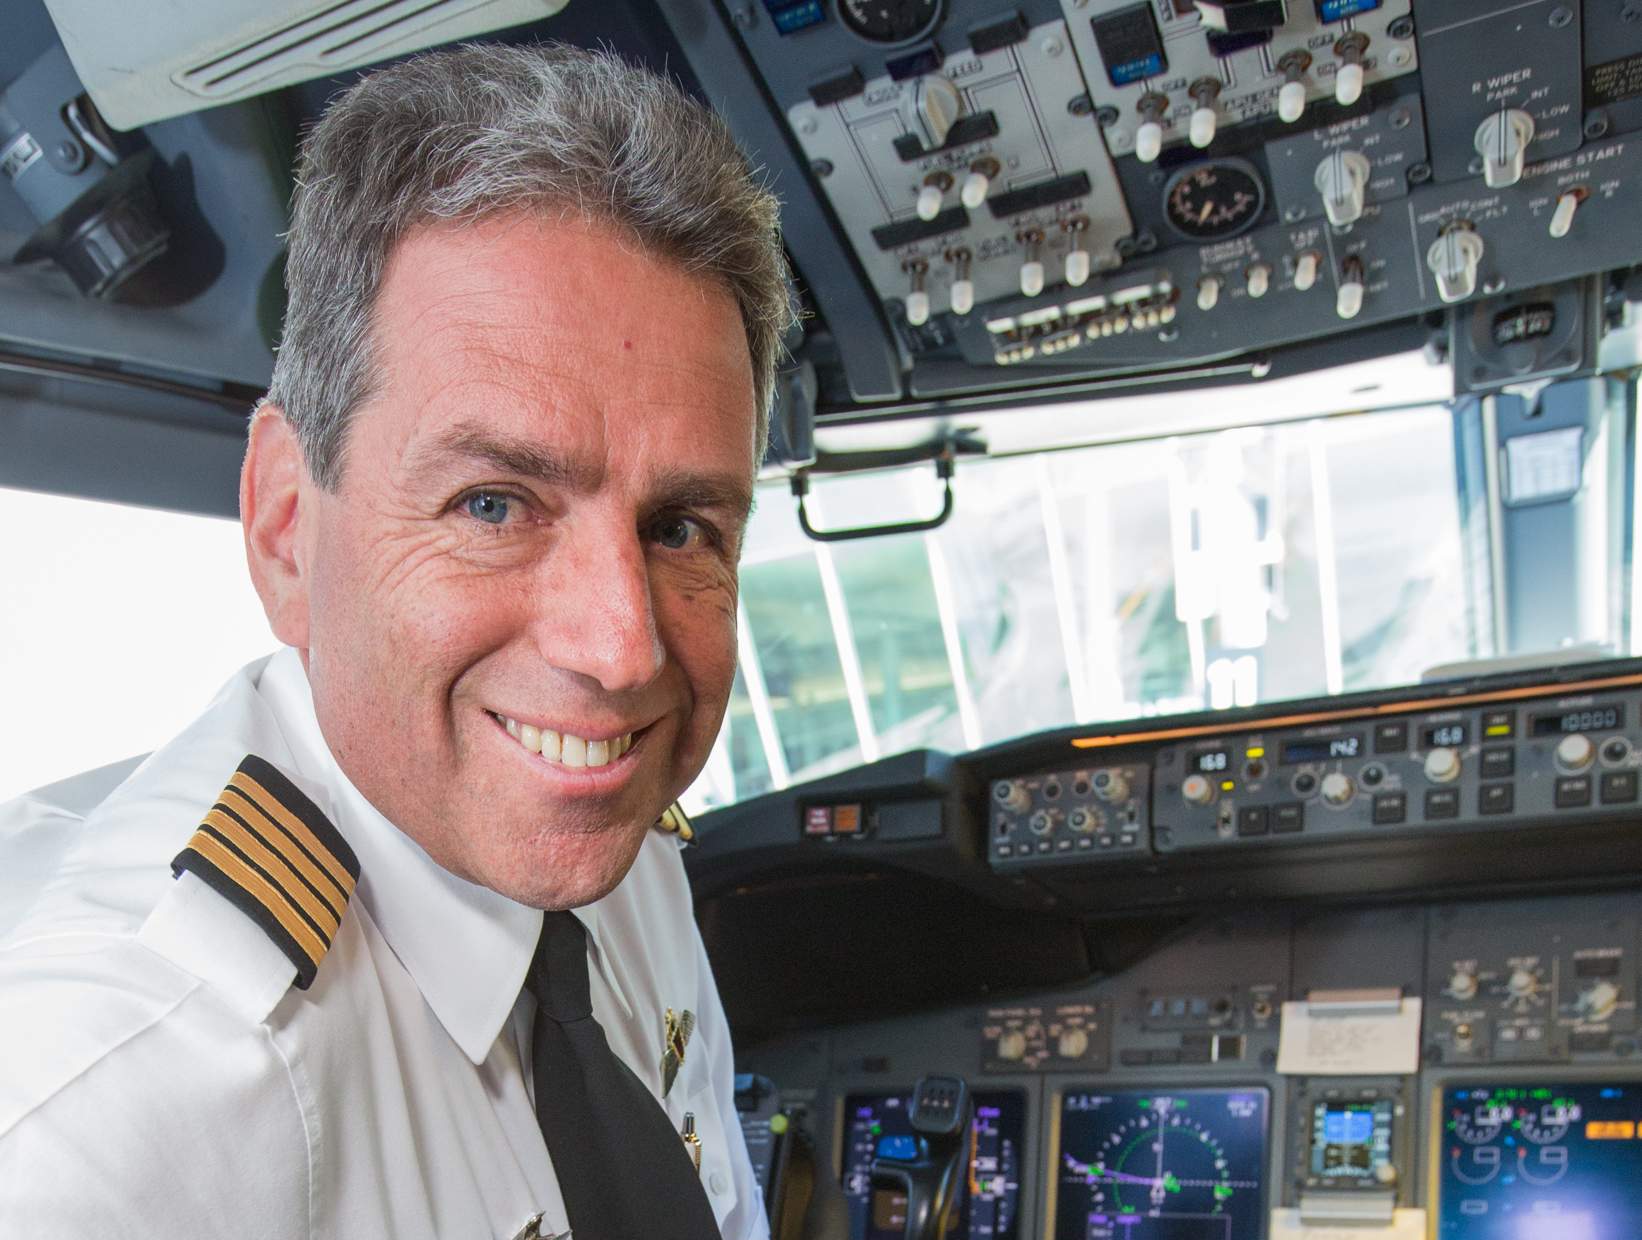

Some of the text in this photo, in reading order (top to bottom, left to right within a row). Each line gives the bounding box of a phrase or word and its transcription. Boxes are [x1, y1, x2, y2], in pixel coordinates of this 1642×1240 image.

[1472, 68, 1532, 94] R WIPER
[1487, 87, 1517, 102] PARK
[1531, 87, 1549, 100] INT
[1542, 104, 1570, 119] LOW
[1329, 116, 1369, 135] WIPER
[1522, 144, 1624, 180] ENGINE START
